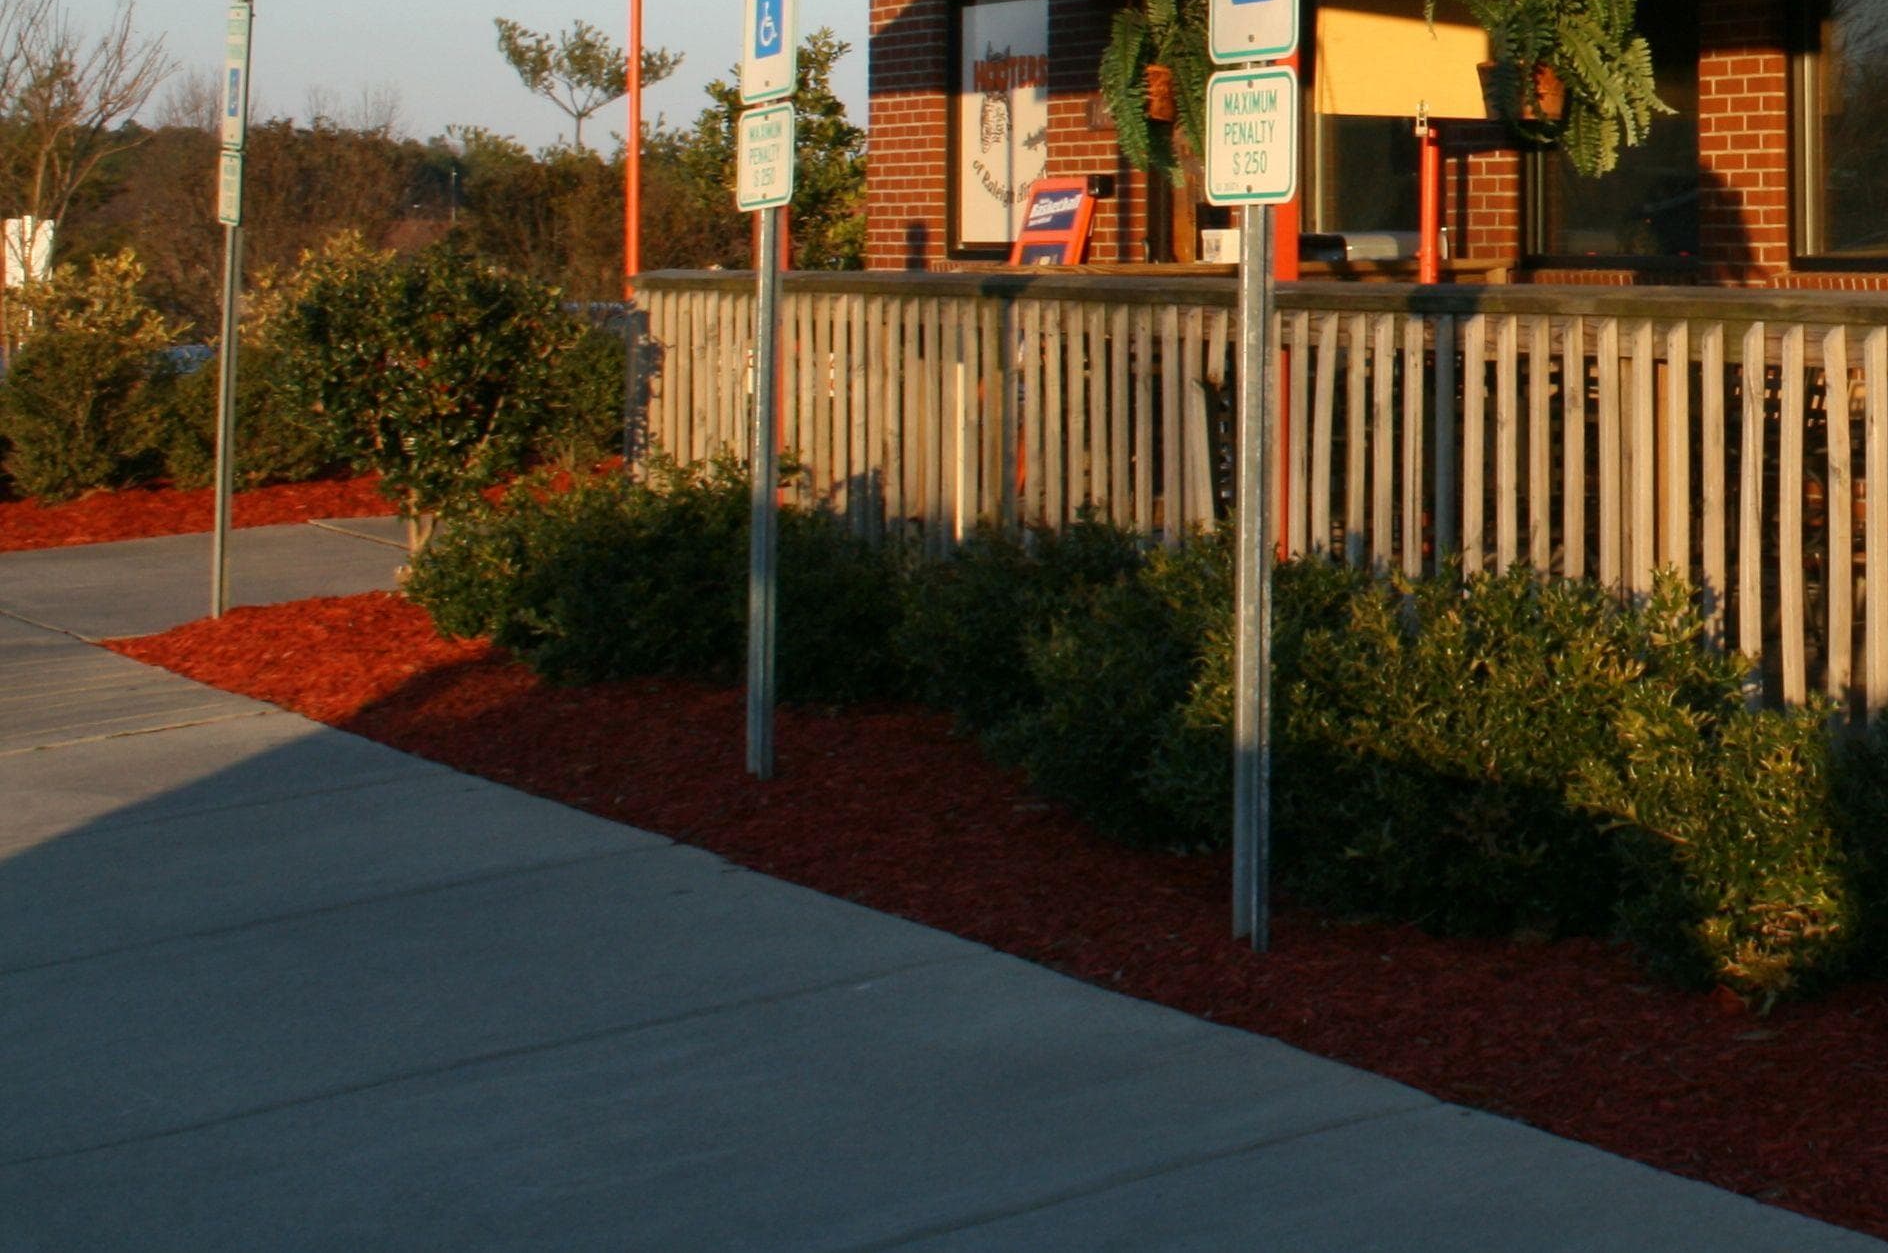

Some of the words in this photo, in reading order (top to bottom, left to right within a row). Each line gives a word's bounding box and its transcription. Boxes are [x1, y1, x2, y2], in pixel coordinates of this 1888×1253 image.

[1223, 89, 1278, 116] MAXIMUM
[1224, 119, 1276, 146] PENALTY
[1244, 149, 1268, 175] 250
